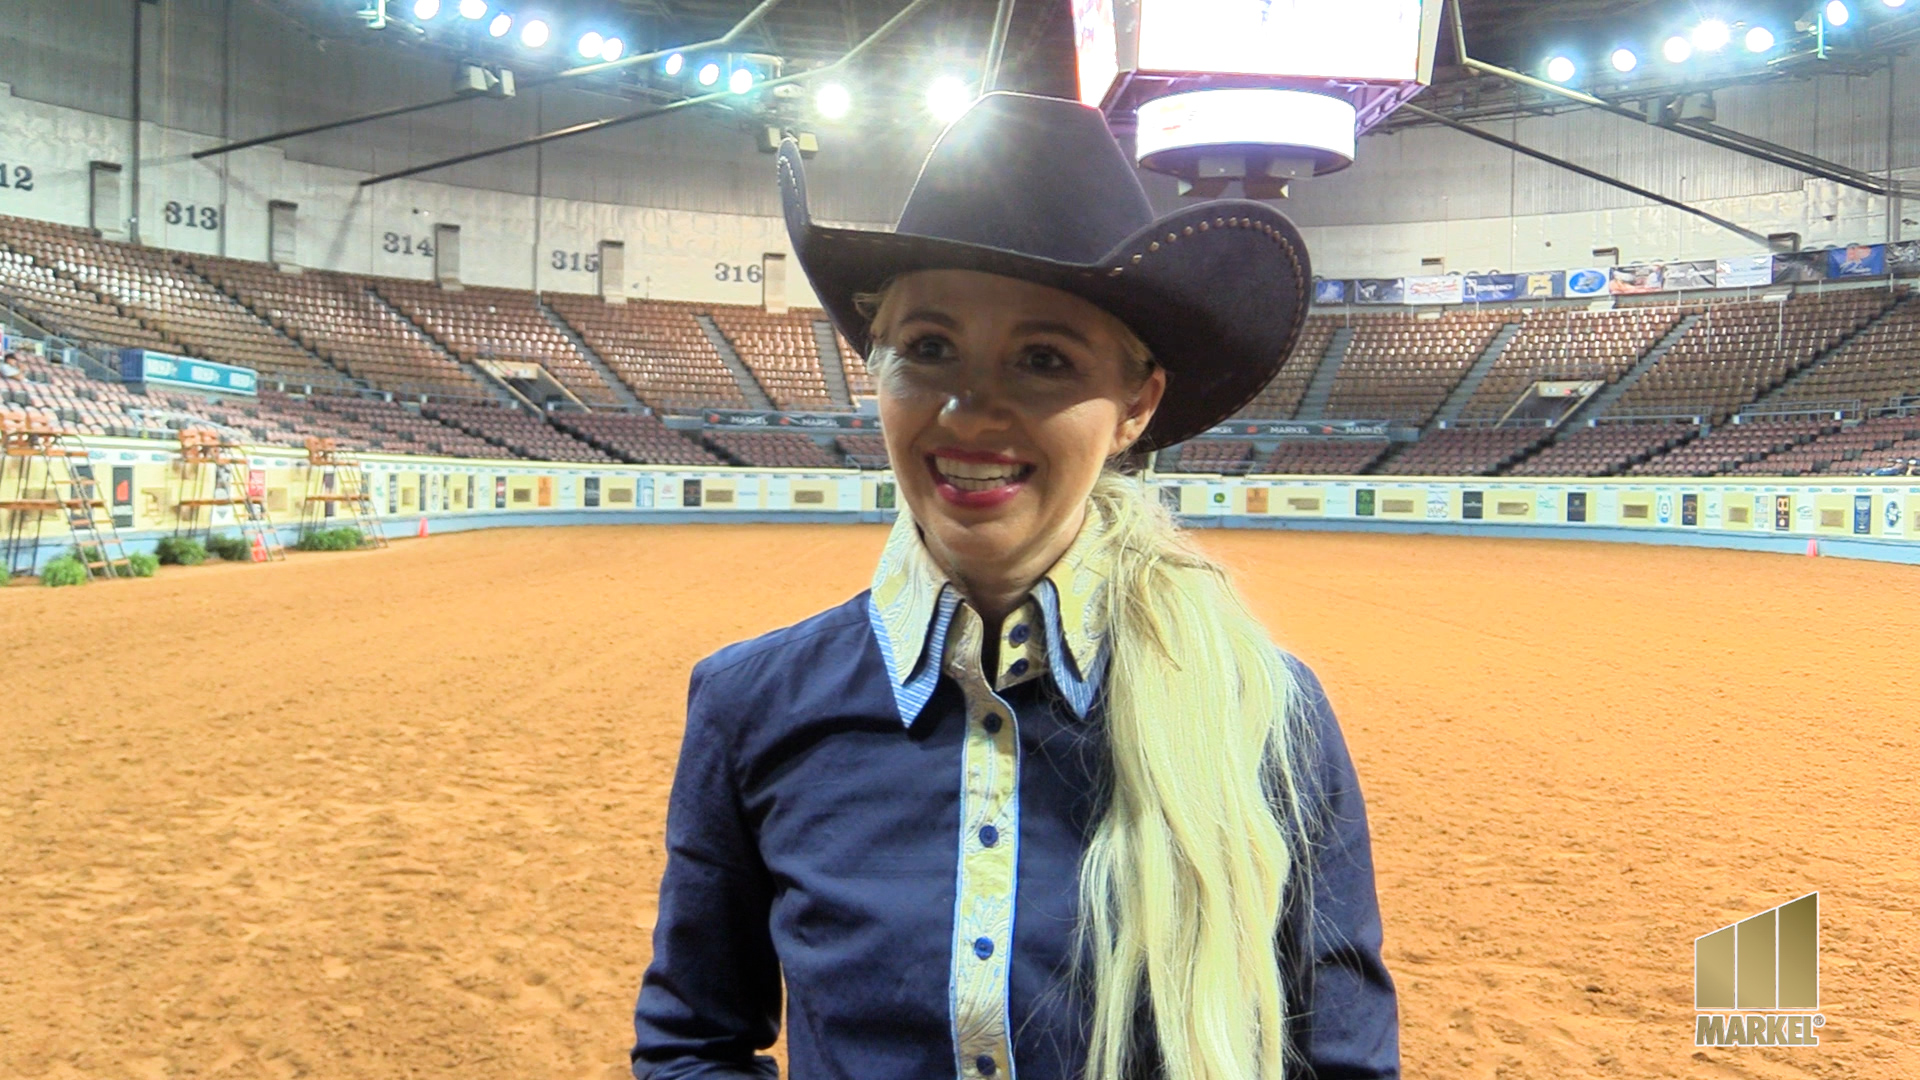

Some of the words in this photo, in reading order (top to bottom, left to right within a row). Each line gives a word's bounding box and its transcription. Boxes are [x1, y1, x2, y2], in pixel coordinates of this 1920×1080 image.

[165, 200, 218, 230] 313
[383, 231, 434, 257] 314
[551, 250, 600, 273] 315
[715, 262, 763, 283] 316
[1269, 425, 1309, 434] MARKEL
